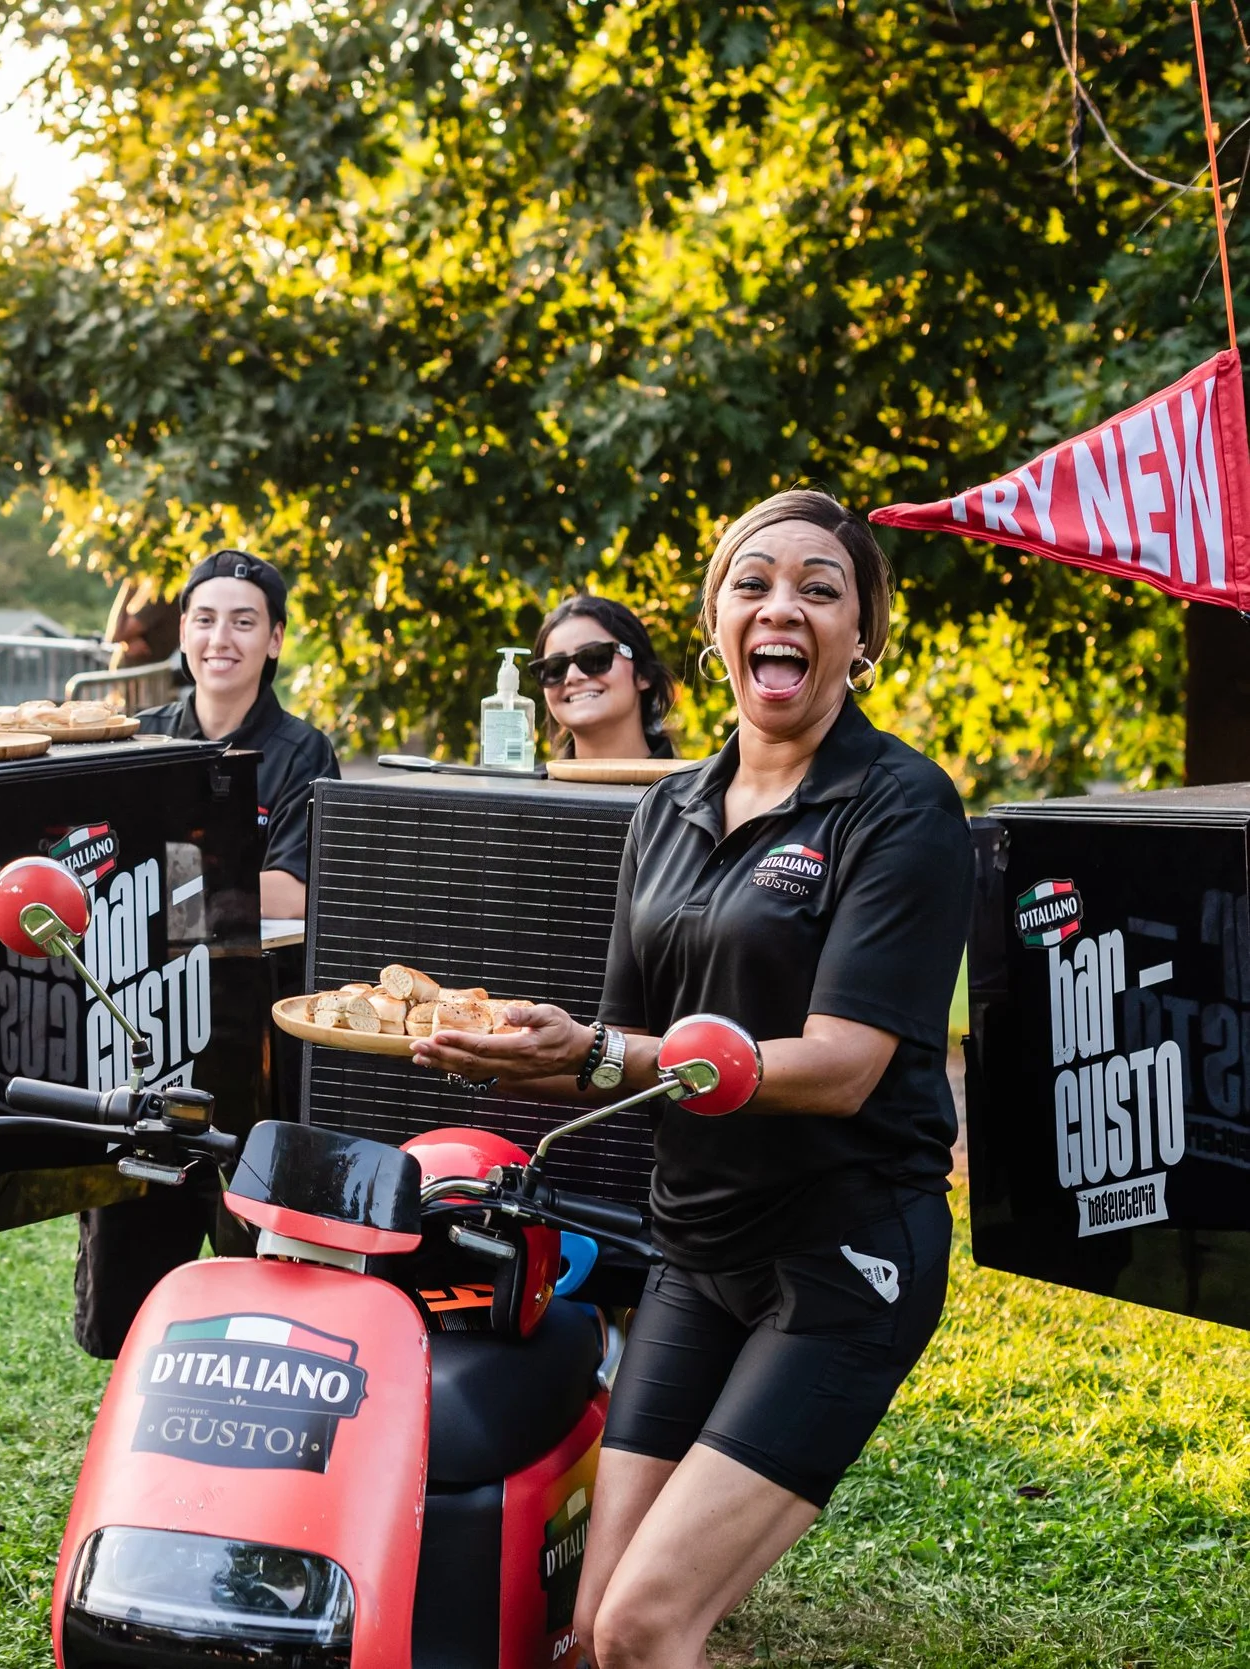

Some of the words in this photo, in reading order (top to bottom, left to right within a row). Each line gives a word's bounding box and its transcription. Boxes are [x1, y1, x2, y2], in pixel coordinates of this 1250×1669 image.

[943, 451, 1057, 546] TRY
[1072, 375, 1227, 590] NEW
[758, 855, 823, 877] D'ITALIANO
[1018, 895, 1078, 931] D'ITALIANO
[1053, 1040, 1185, 1189] GUSTO
[1087, 1182, 1157, 1229] bageleteria
[150, 1352, 350, 1404] D'ITALIANO
[160, 1415, 308, 1458] GUSTO!
[552, 1636, 569, 1662] DO
